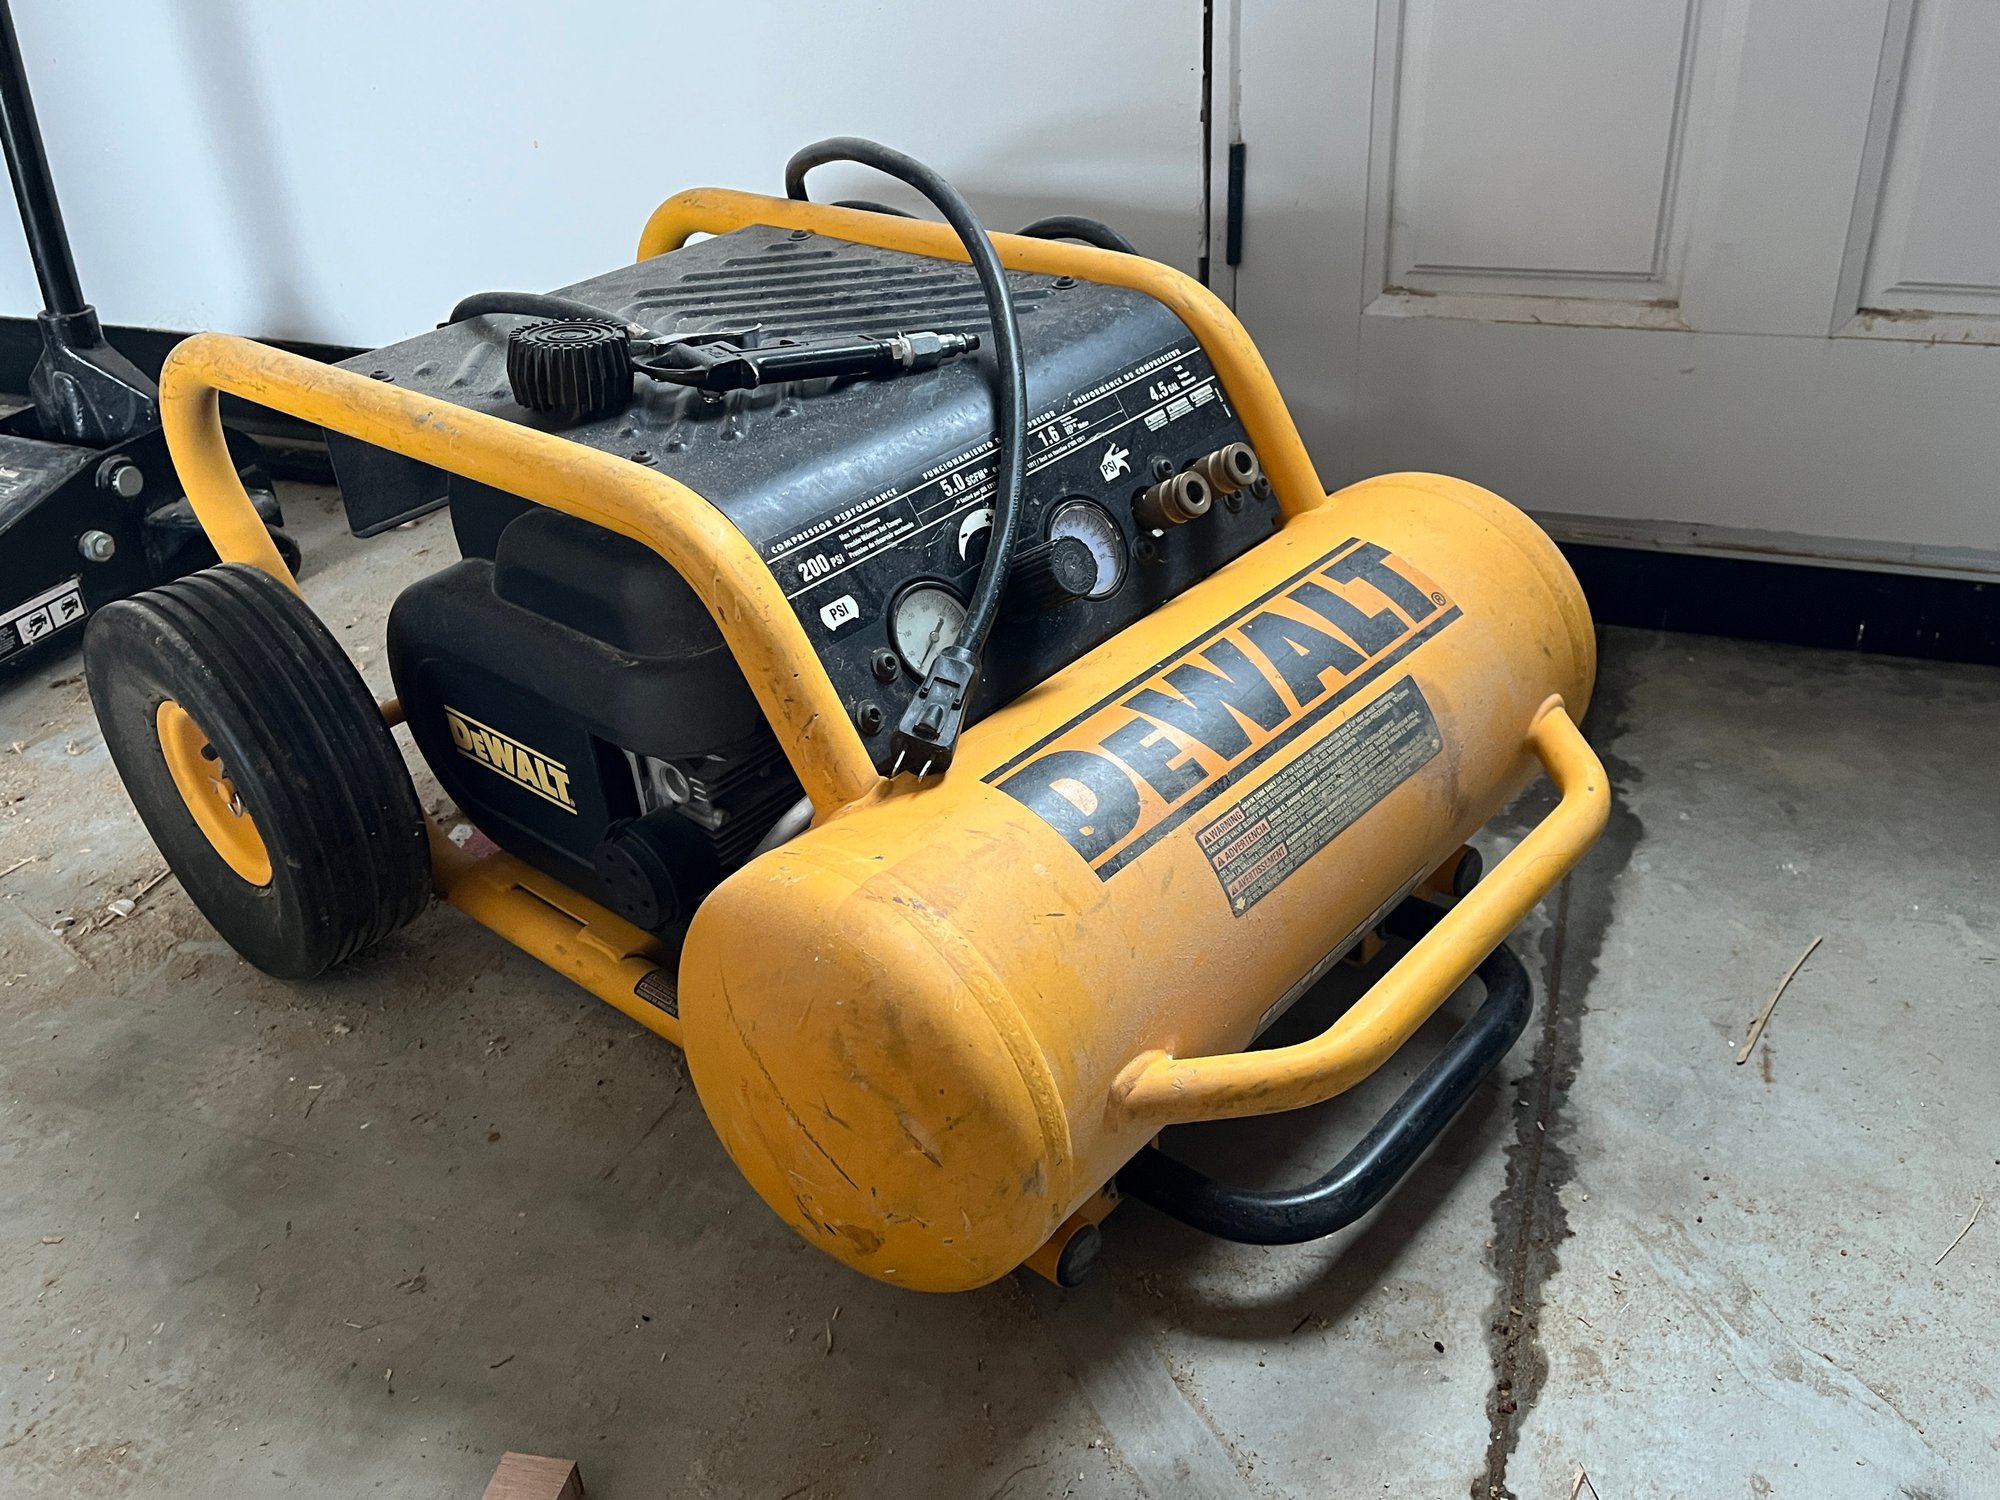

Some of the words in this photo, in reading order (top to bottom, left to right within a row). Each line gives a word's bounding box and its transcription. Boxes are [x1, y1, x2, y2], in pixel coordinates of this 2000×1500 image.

[1073, 377, 1123, 407] PERFORMANCE
[1124, 371, 1135, 382] DU
[1135, 348, 1181, 375] COMPRESSEUR
[1149, 381, 1169, 401] 4.5
[1038, 425, 1061, 447] 1.6
[922, 441, 994, 480] FUNCIONAMIENTO
[1102, 460, 1118, 476] PSI
[939, 473, 966, 497] 5.0
[771, 519, 833, 554] COMPRESSOR
[834, 488, 898, 523] PERFORMANCE
[797, 553, 830, 582] 200
[829, 553, 846, 568] PSI
[829, 602, 849, 621] PSI
[996, 542, 1438, 864] DEWALT
[1209, 810, 1243, 840] WARNING
[1224, 822, 1269, 862] ADVERTENCIA
[1238, 846, 1285, 889] AVERTISSEMENT
